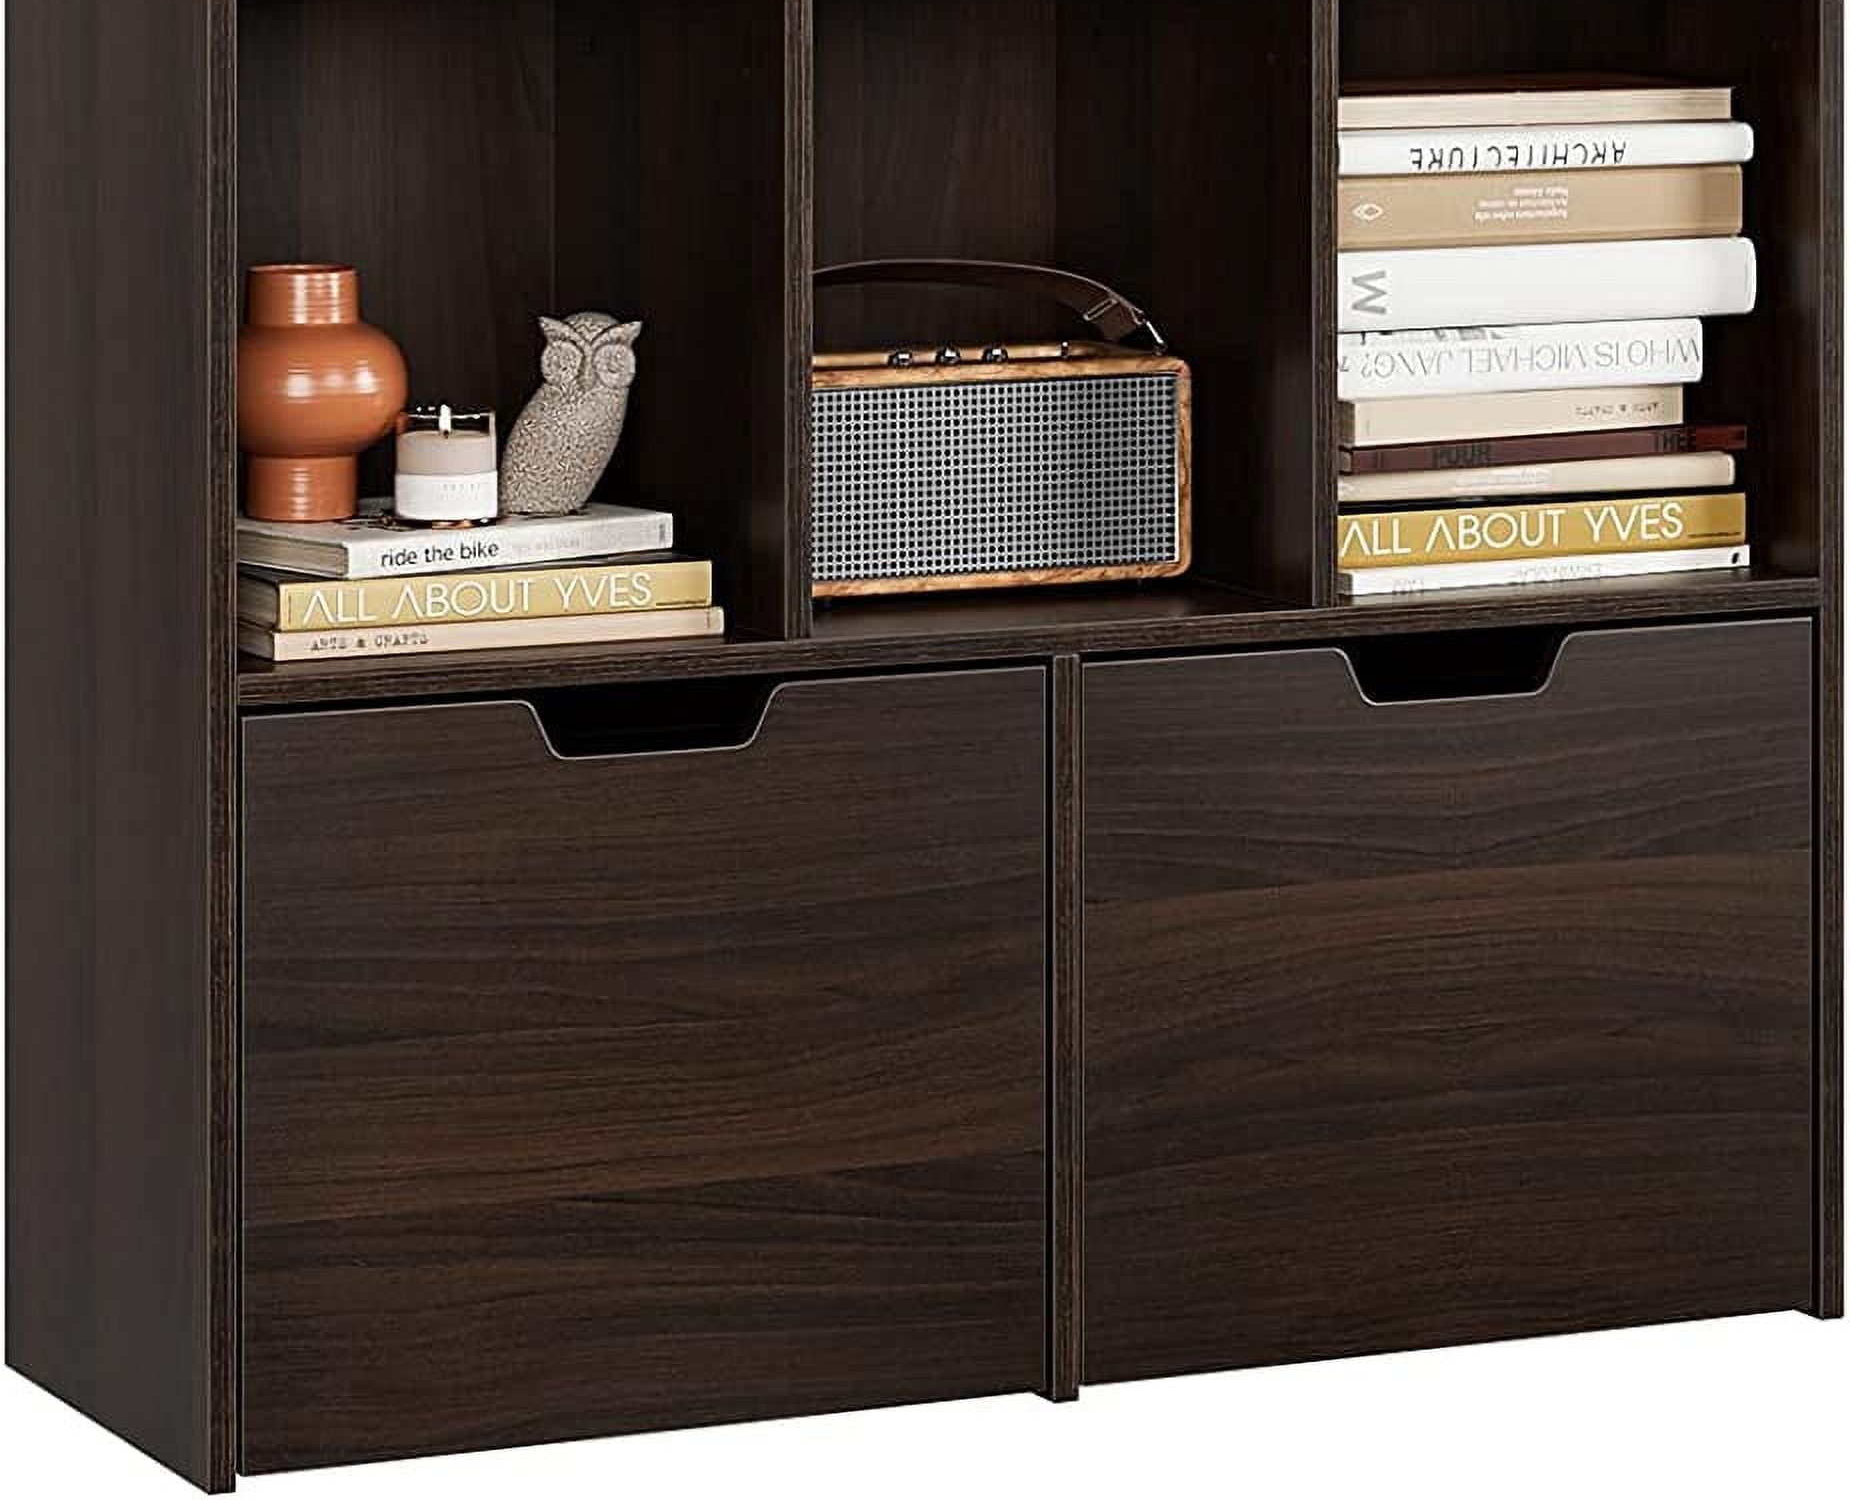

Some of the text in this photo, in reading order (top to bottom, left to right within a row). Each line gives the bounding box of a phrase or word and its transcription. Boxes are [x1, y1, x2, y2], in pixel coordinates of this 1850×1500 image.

[1409, 141, 1627, 171] ARCHITECTURE
[1461, 344, 1587, 374] MICHAEL
[1594, 342, 1620, 368] IS
[1627, 339, 1700, 367] WHO
[1340, 500, 1684, 558] ALL ABOUT YVES
[381, 541, 500, 568] ride the bike
[302, 571, 653, 625] ALL ABOUT YVES
